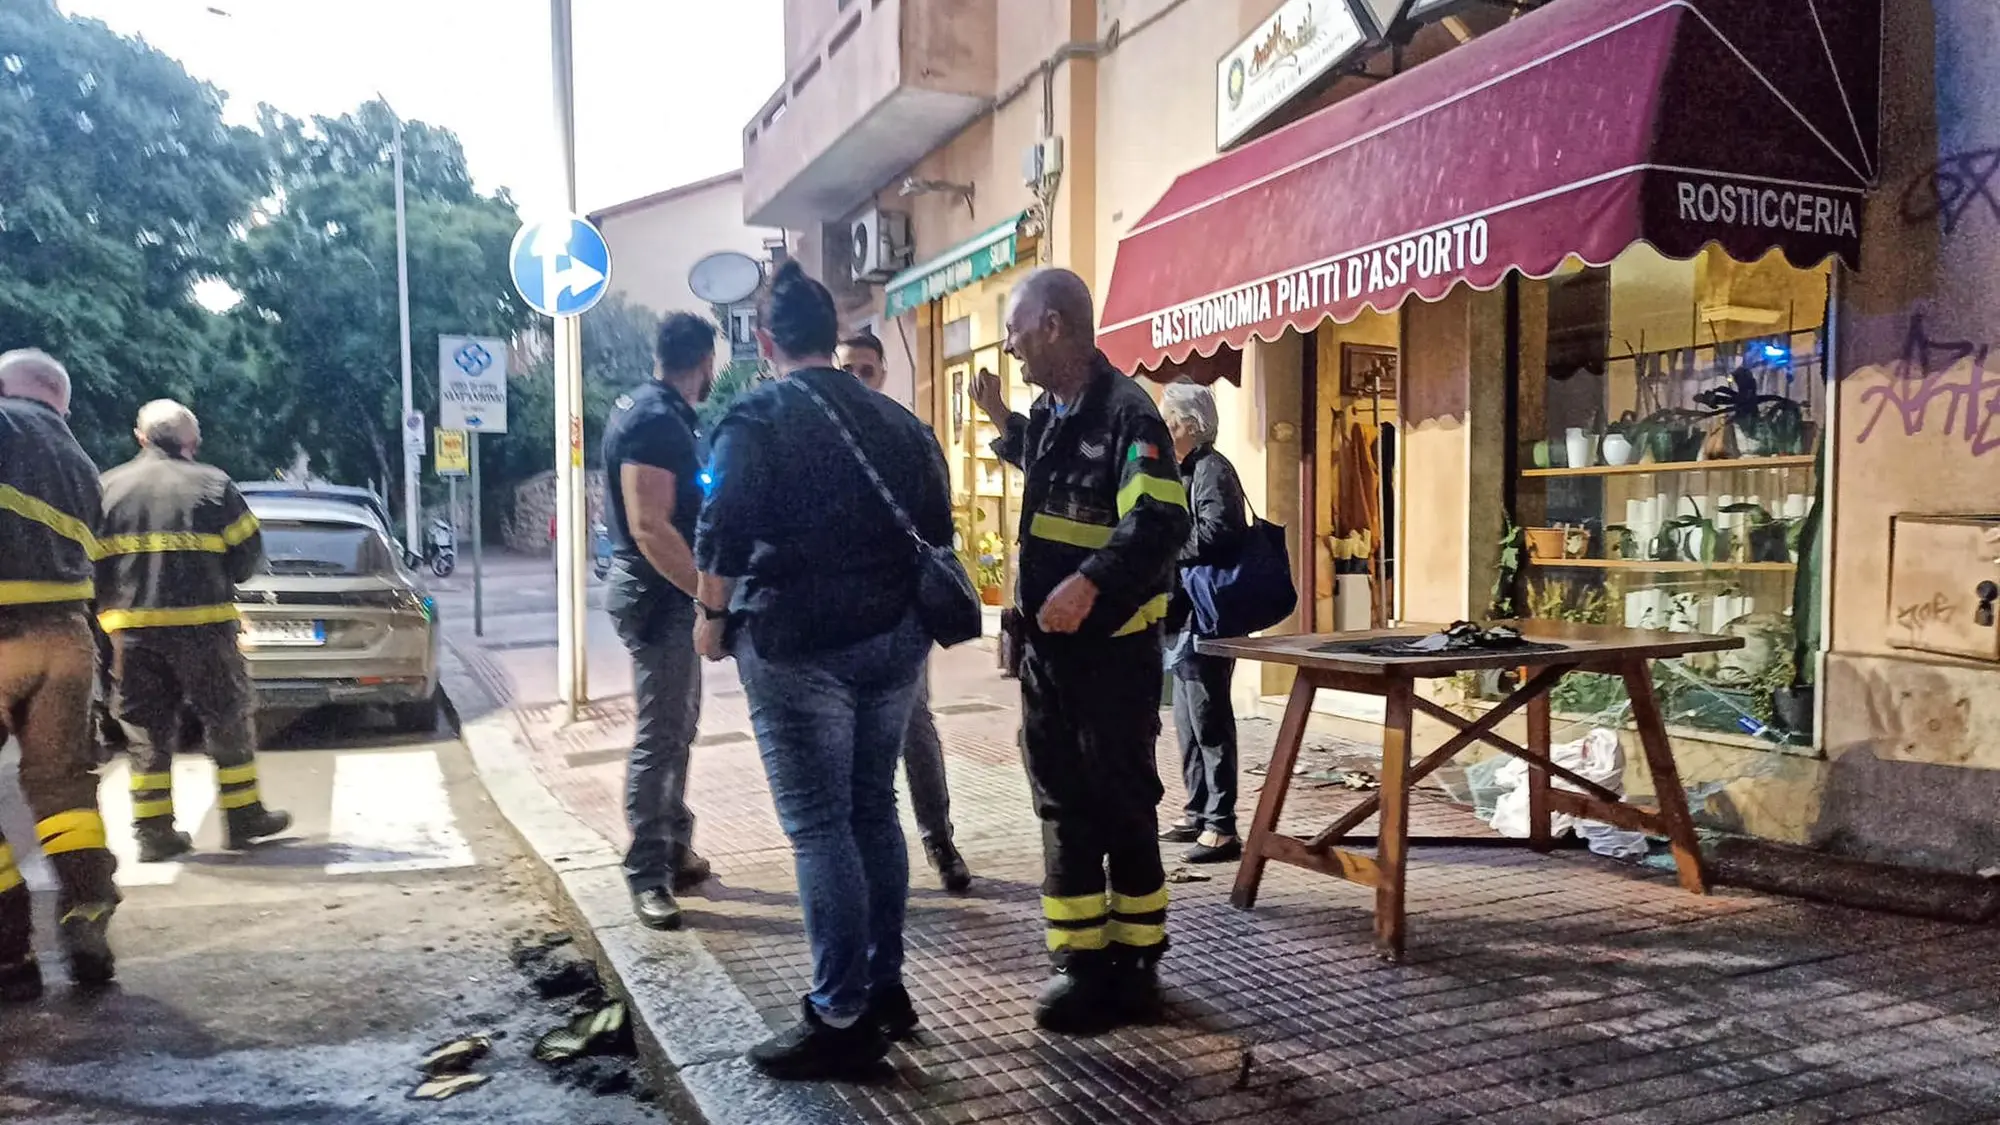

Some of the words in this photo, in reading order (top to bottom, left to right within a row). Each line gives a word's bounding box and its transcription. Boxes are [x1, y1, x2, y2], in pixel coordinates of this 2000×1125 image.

[1677, 181, 1858, 239] ROSTICCERIA
[1151, 283, 1272, 349] GASTRONOMIA
[1276, 263, 1341, 317] PIATTI
[1347, 218, 1489, 299] D'ASPORTO
